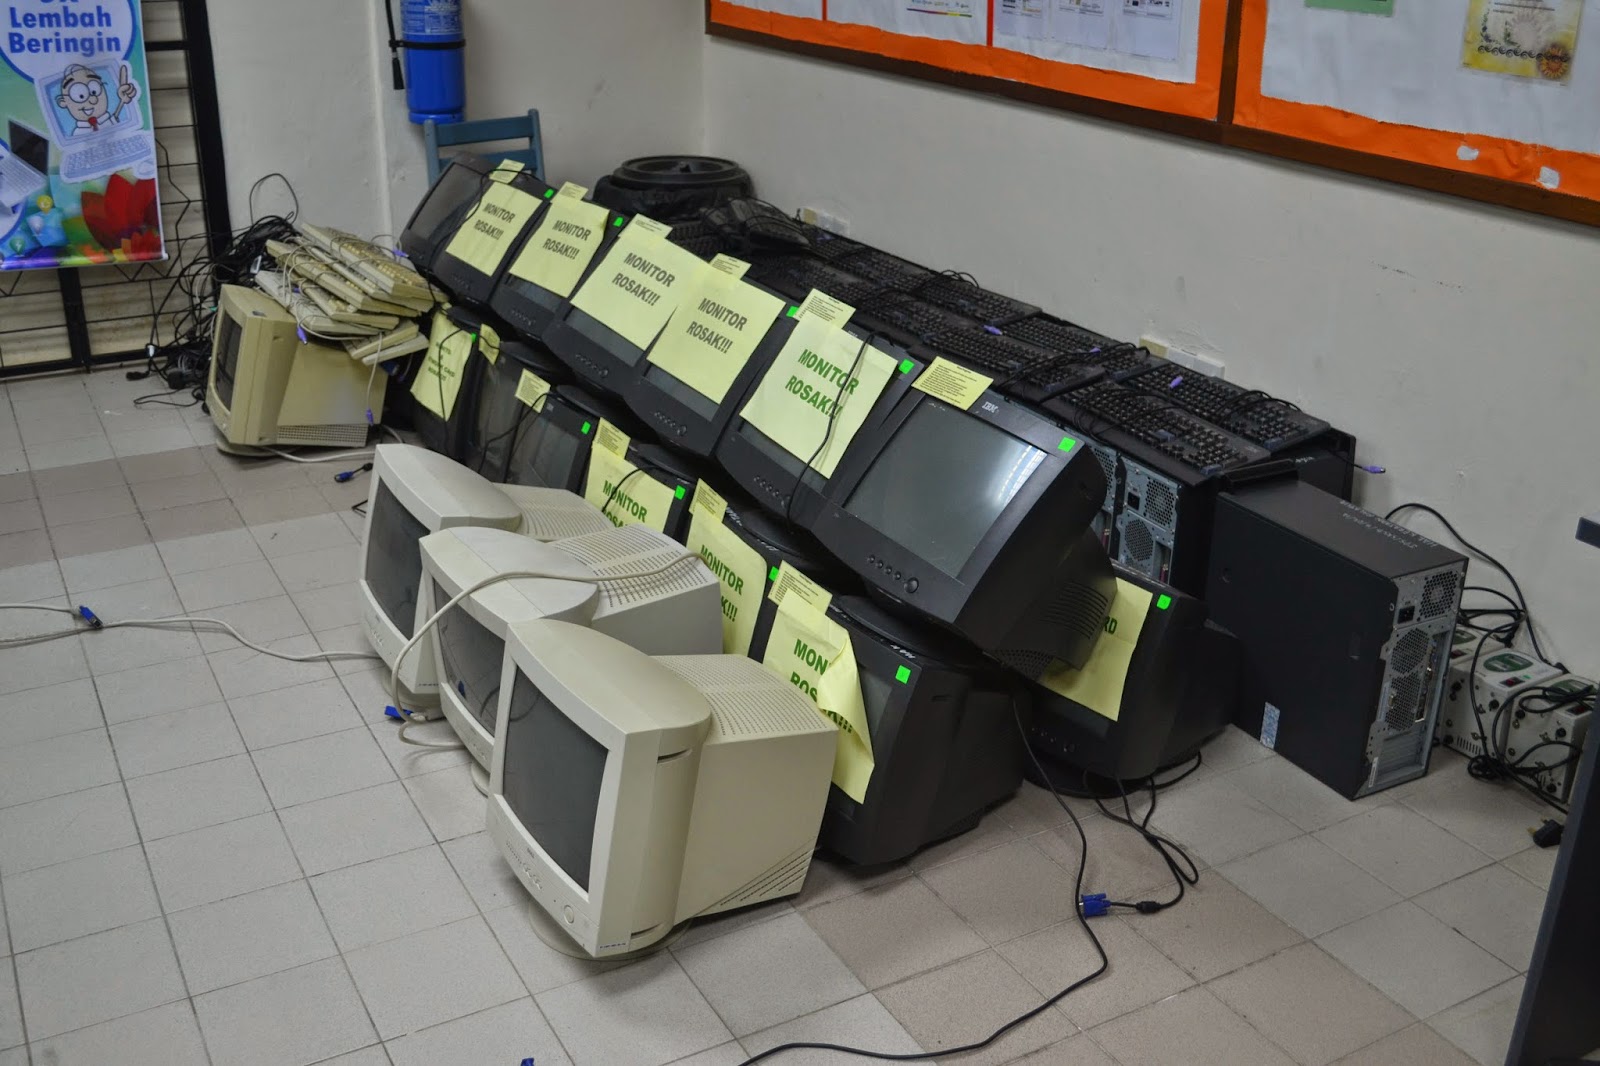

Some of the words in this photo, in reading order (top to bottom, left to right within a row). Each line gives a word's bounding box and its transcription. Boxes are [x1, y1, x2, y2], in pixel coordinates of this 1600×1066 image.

[9, 5, 112, 28] Lembah
[8, 31, 121, 57] Beringin
[482, 203, 516, 224] MONITOR
[473, 219, 504, 241] ROSAK!!!
[552, 220, 592, 241] MONITOR
[542, 238, 580, 260] ROSAK!!!
[623, 252, 676, 288] MONITOR
[611, 272, 661, 307] ROSAK!!!
[698, 298, 748, 331] MONITOR
[686, 321, 733, 354] ROSAK!!!
[798, 349, 859, 395] MONITOR
[981, 401, 999, 413] IBM
[721, 595, 738, 622] K!!!
[794, 639, 830, 676] MON
